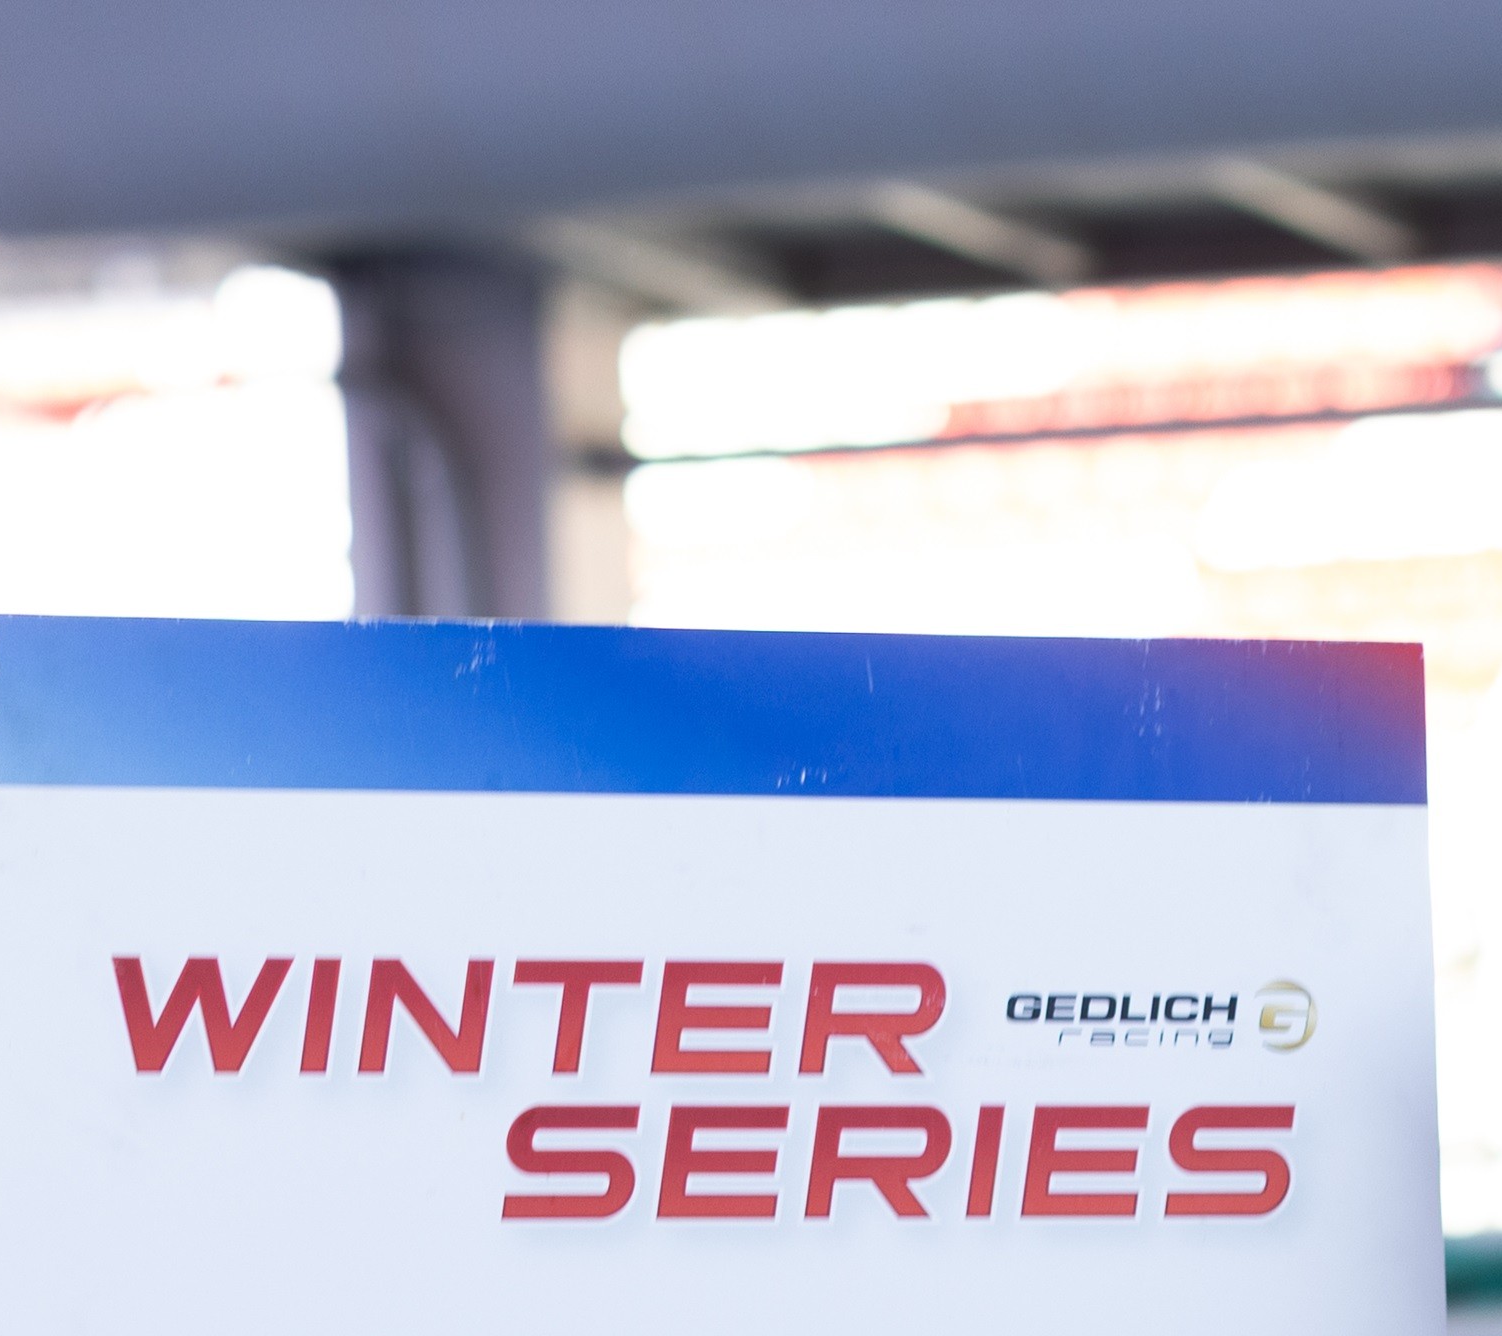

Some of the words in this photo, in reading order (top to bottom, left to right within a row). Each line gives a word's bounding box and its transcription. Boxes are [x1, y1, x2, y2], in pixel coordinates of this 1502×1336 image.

[110, 956, 948, 1077] WINTER
[1005, 990, 1239, 1024] GEDLICH
[1058, 1028, 1235, 1049] racing
[501, 1103, 1296, 1221] SERIES
